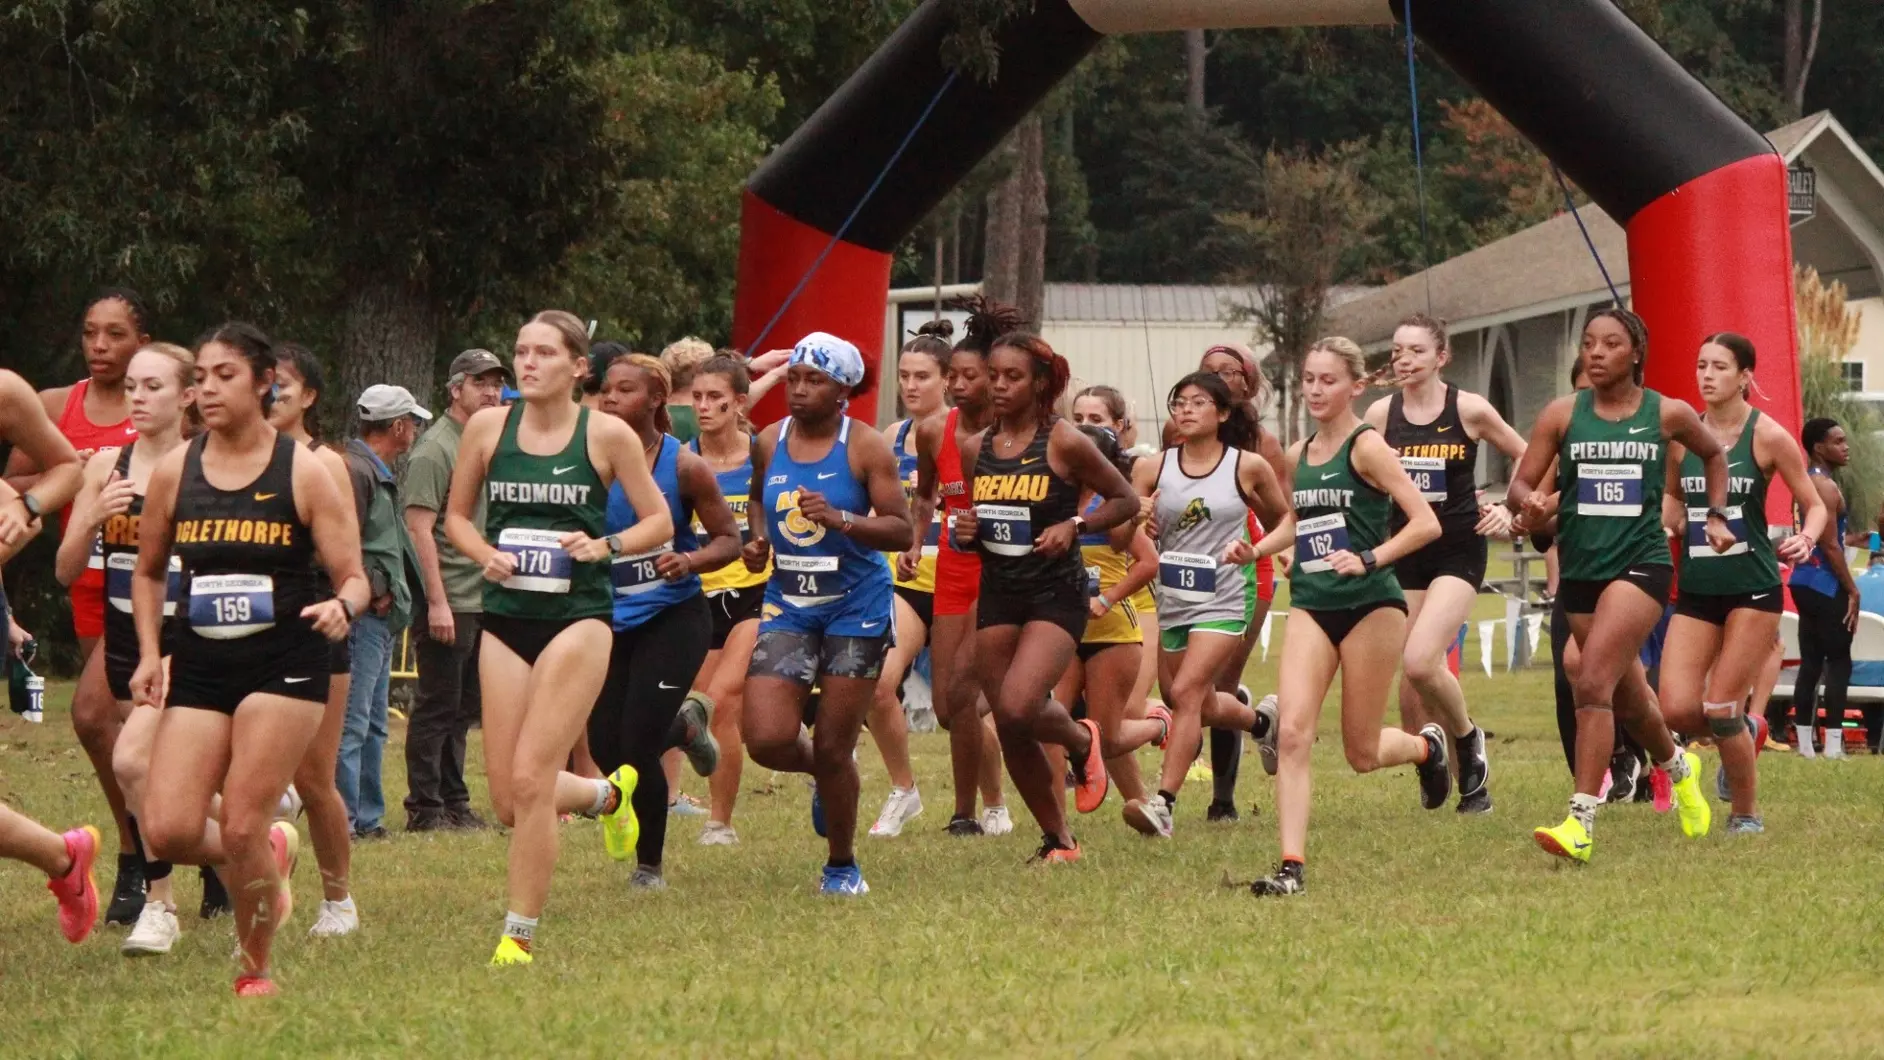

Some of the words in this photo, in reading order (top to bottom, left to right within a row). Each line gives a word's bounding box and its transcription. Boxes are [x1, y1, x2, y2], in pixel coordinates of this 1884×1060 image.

[1570, 441, 1659, 461] PIEDMONT
[490, 481, 591, 505] PIEDMONT
[1594, 482, 1624, 502] 165
[993, 522, 1011, 541] 33
[1308, 533, 1335, 557] 162
[518, 549, 552, 574] 170
[632, 560, 656, 581] 78
[779, 559, 800, 567] NORTH
[1184, 556, 1211, 565] GEORGIA
[195, 581, 223, 589] NORTH
[797, 574, 818, 594] 24
[1178, 569, 1195, 588] 13
[212, 597, 252, 623] 159
